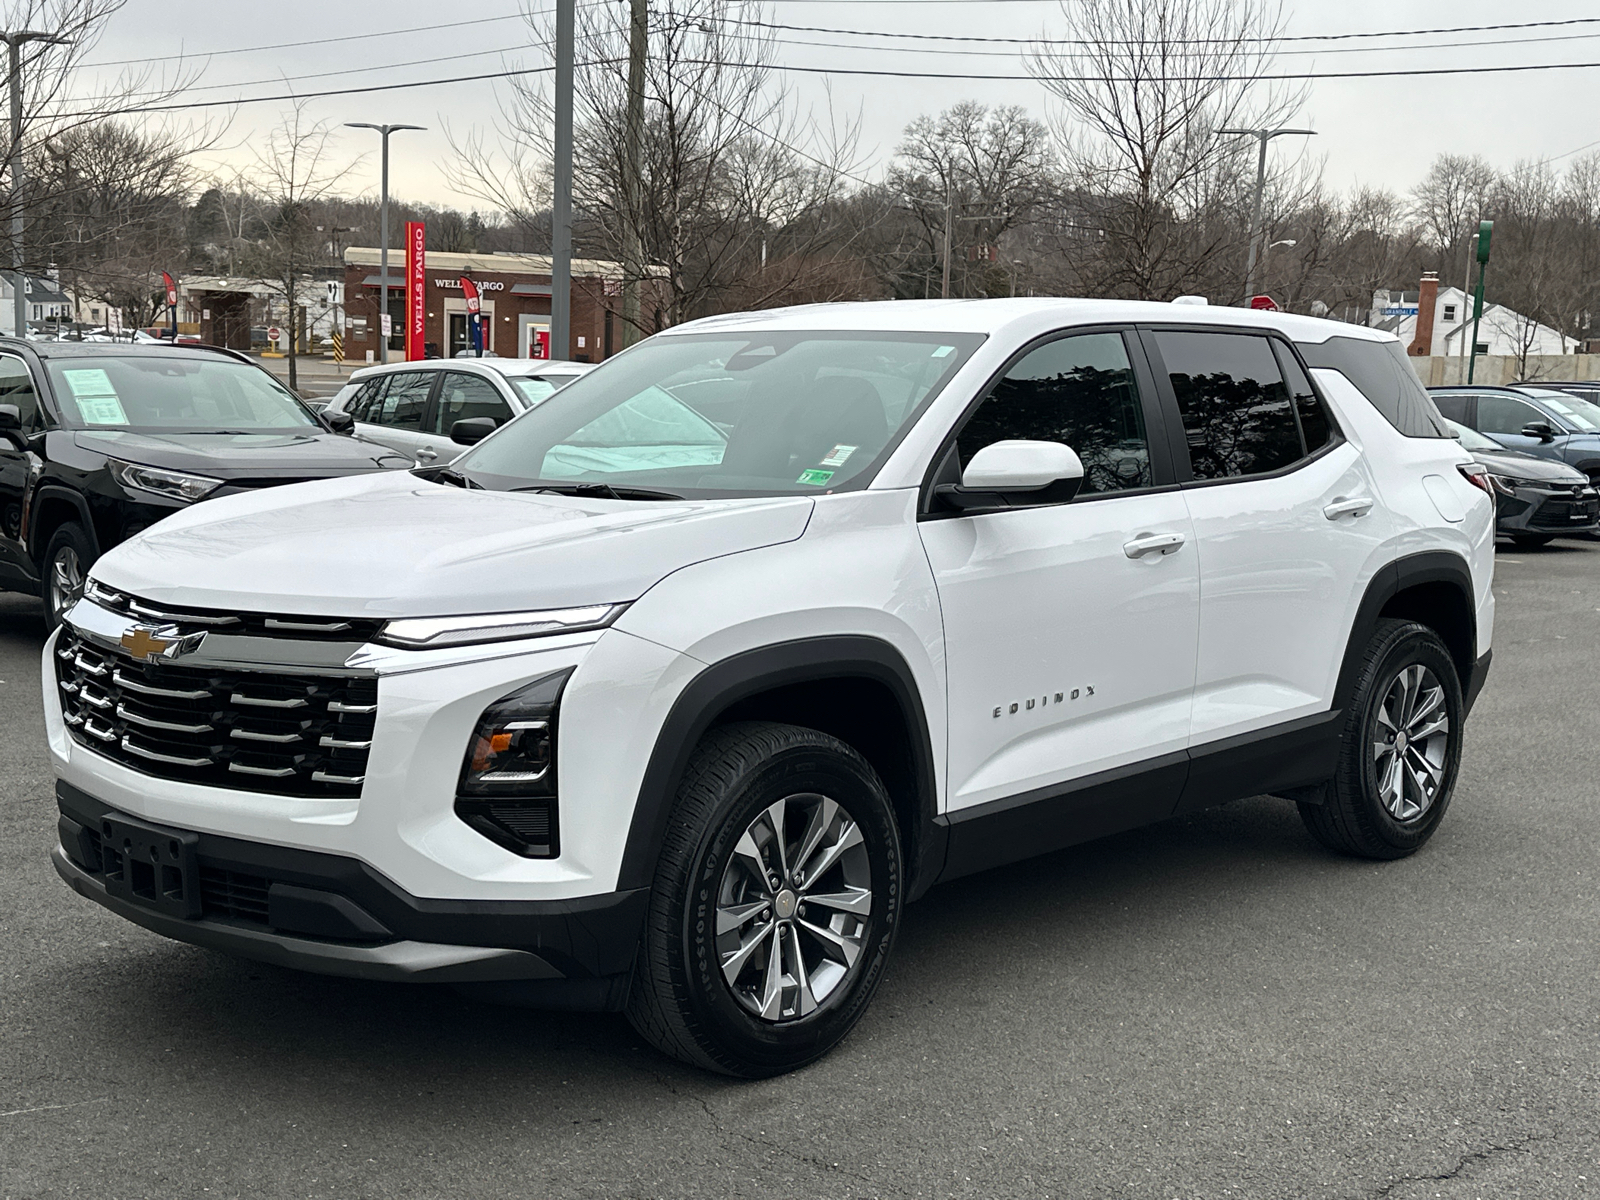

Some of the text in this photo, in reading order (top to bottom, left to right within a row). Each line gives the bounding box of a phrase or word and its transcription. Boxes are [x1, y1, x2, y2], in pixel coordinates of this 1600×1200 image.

[415, 228, 423, 335] WELLS FARGO
[435, 279, 463, 289] WELL
[992, 684, 1096, 719] EQUINOX
